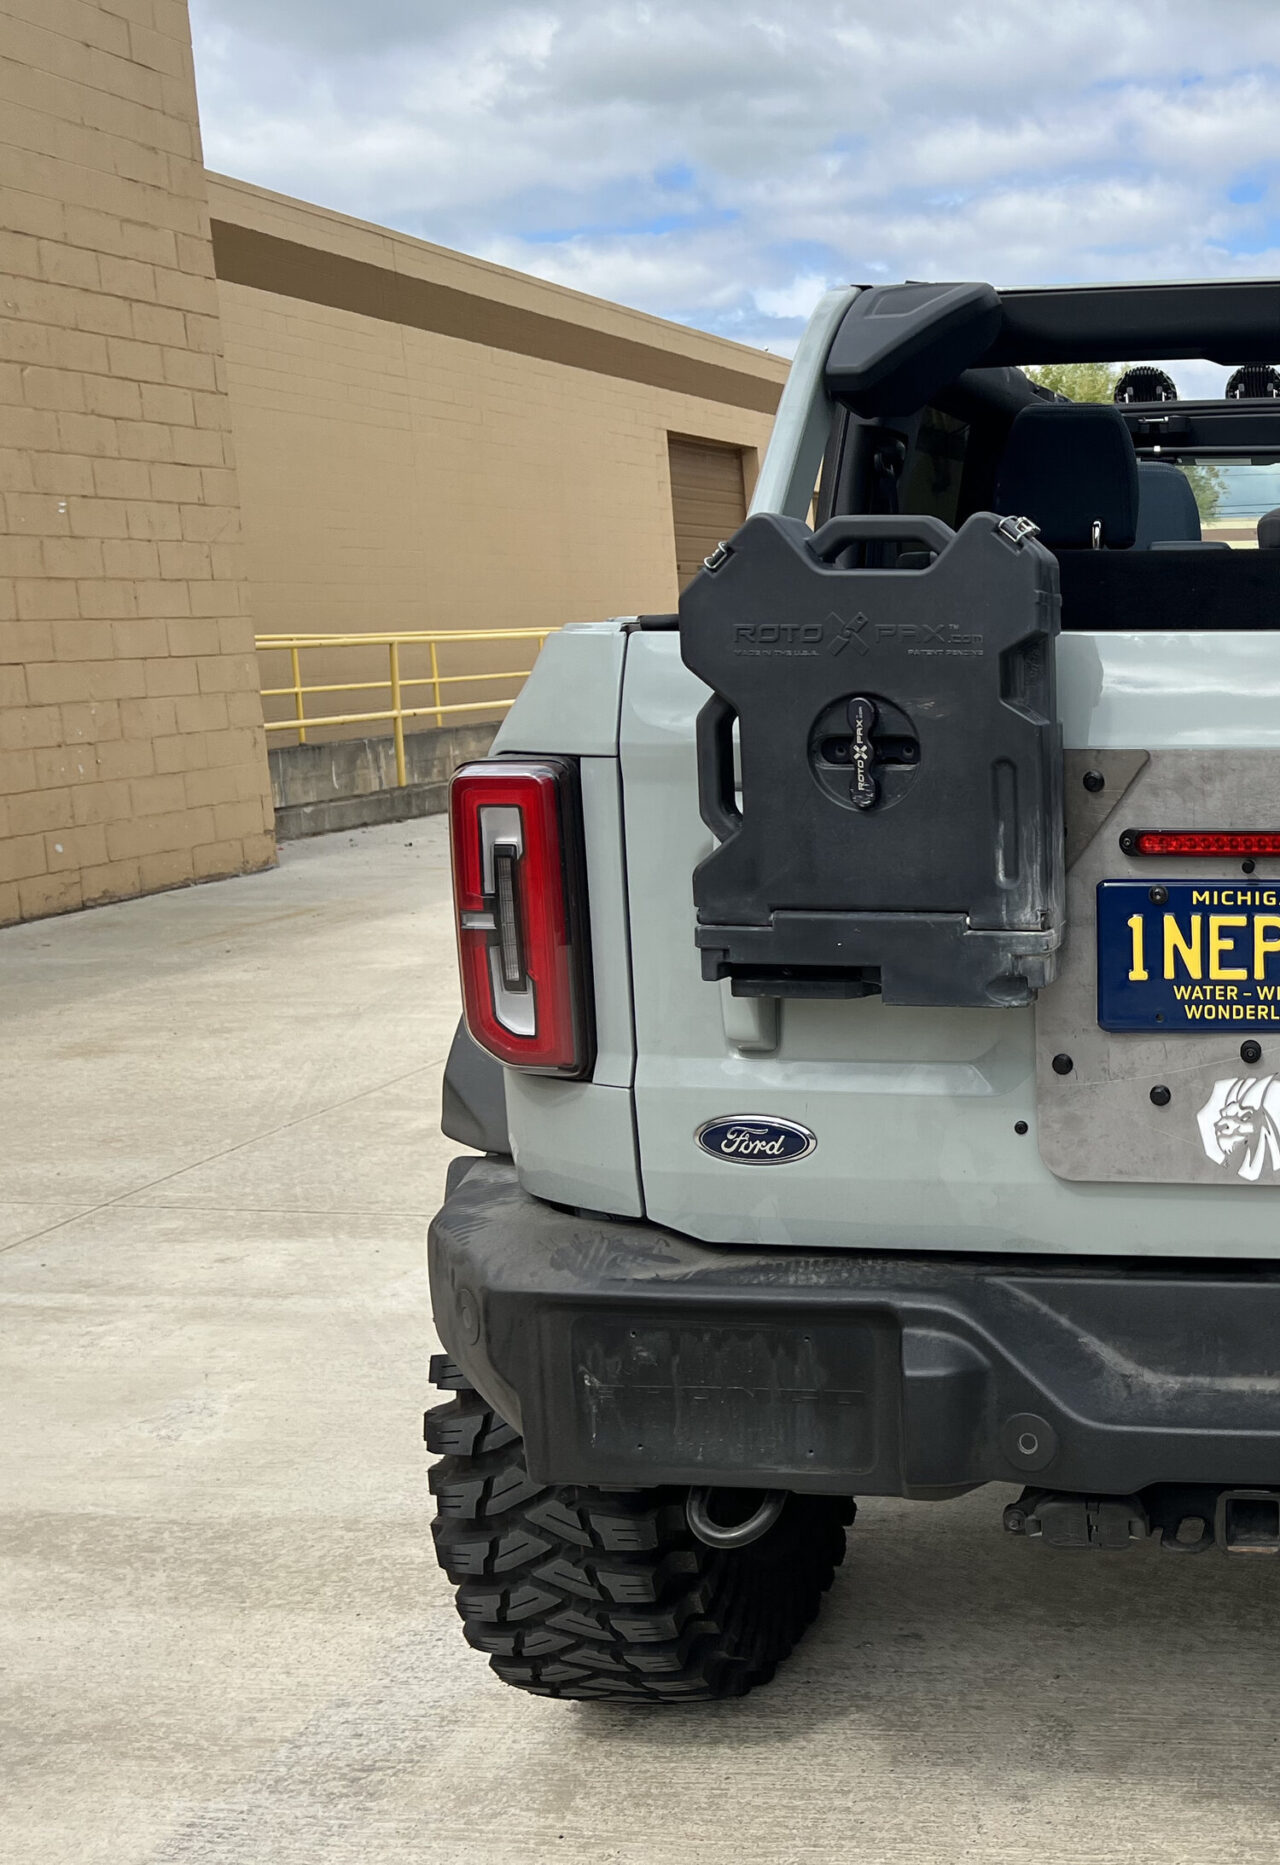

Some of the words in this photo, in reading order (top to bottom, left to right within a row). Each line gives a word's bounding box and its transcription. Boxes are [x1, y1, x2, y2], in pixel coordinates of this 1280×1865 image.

[733, 623, 823, 643] ROTO
[857, 759, 865, 791] ROTO
[1174, 985, 1238, 1001] WATER
[720, 1126, 785, 1155] Ford
